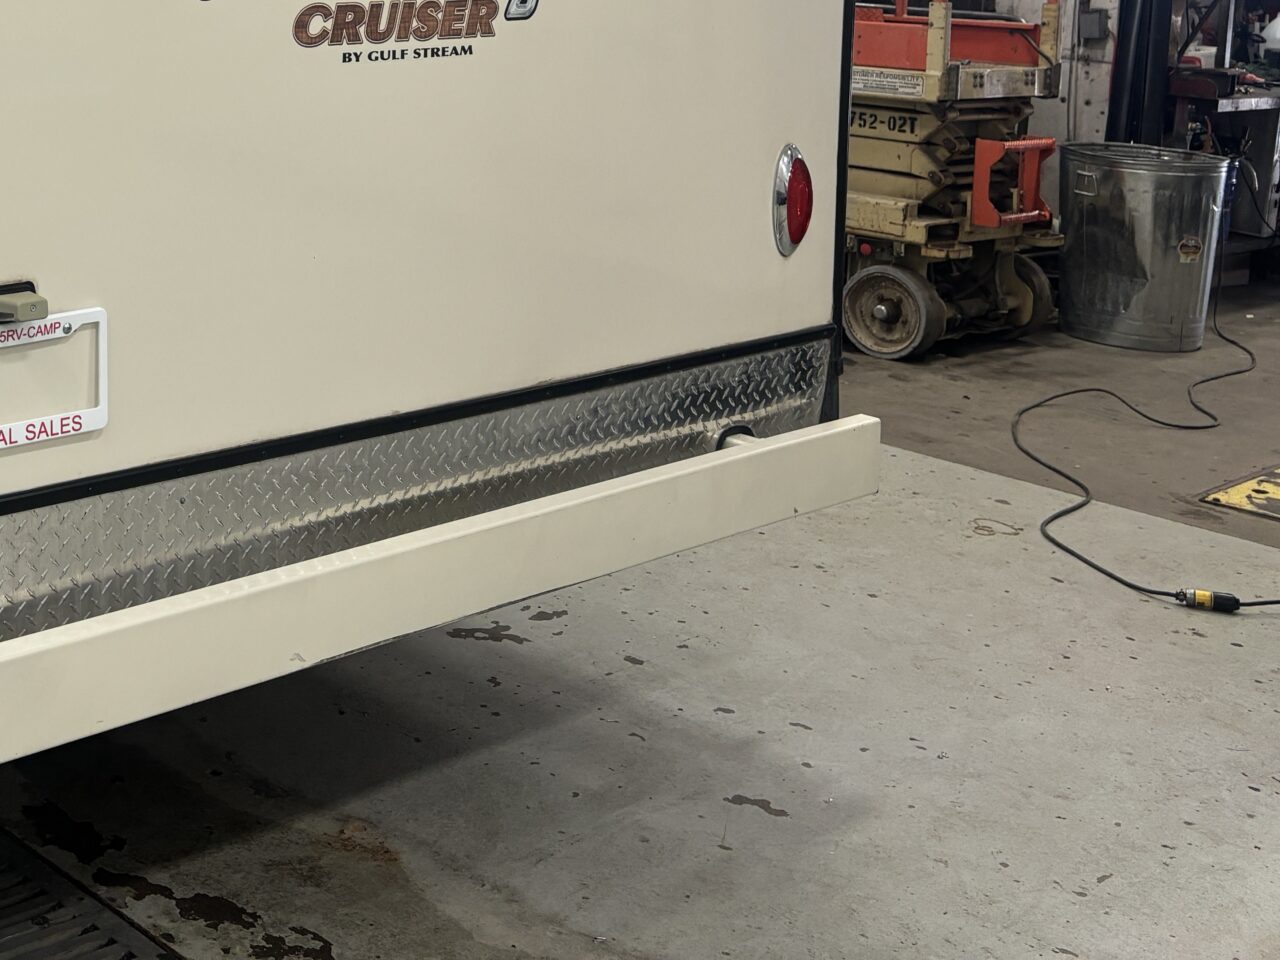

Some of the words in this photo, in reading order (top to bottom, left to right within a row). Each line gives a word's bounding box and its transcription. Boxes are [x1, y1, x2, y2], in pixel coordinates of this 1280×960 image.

[342, 51, 364, 63] BY
[367, 48, 409, 62] GULF
[412, 45, 473, 60] STREAM
[850, 111, 918, 134] 752-02T
[25, 415, 83, 441] SALES
